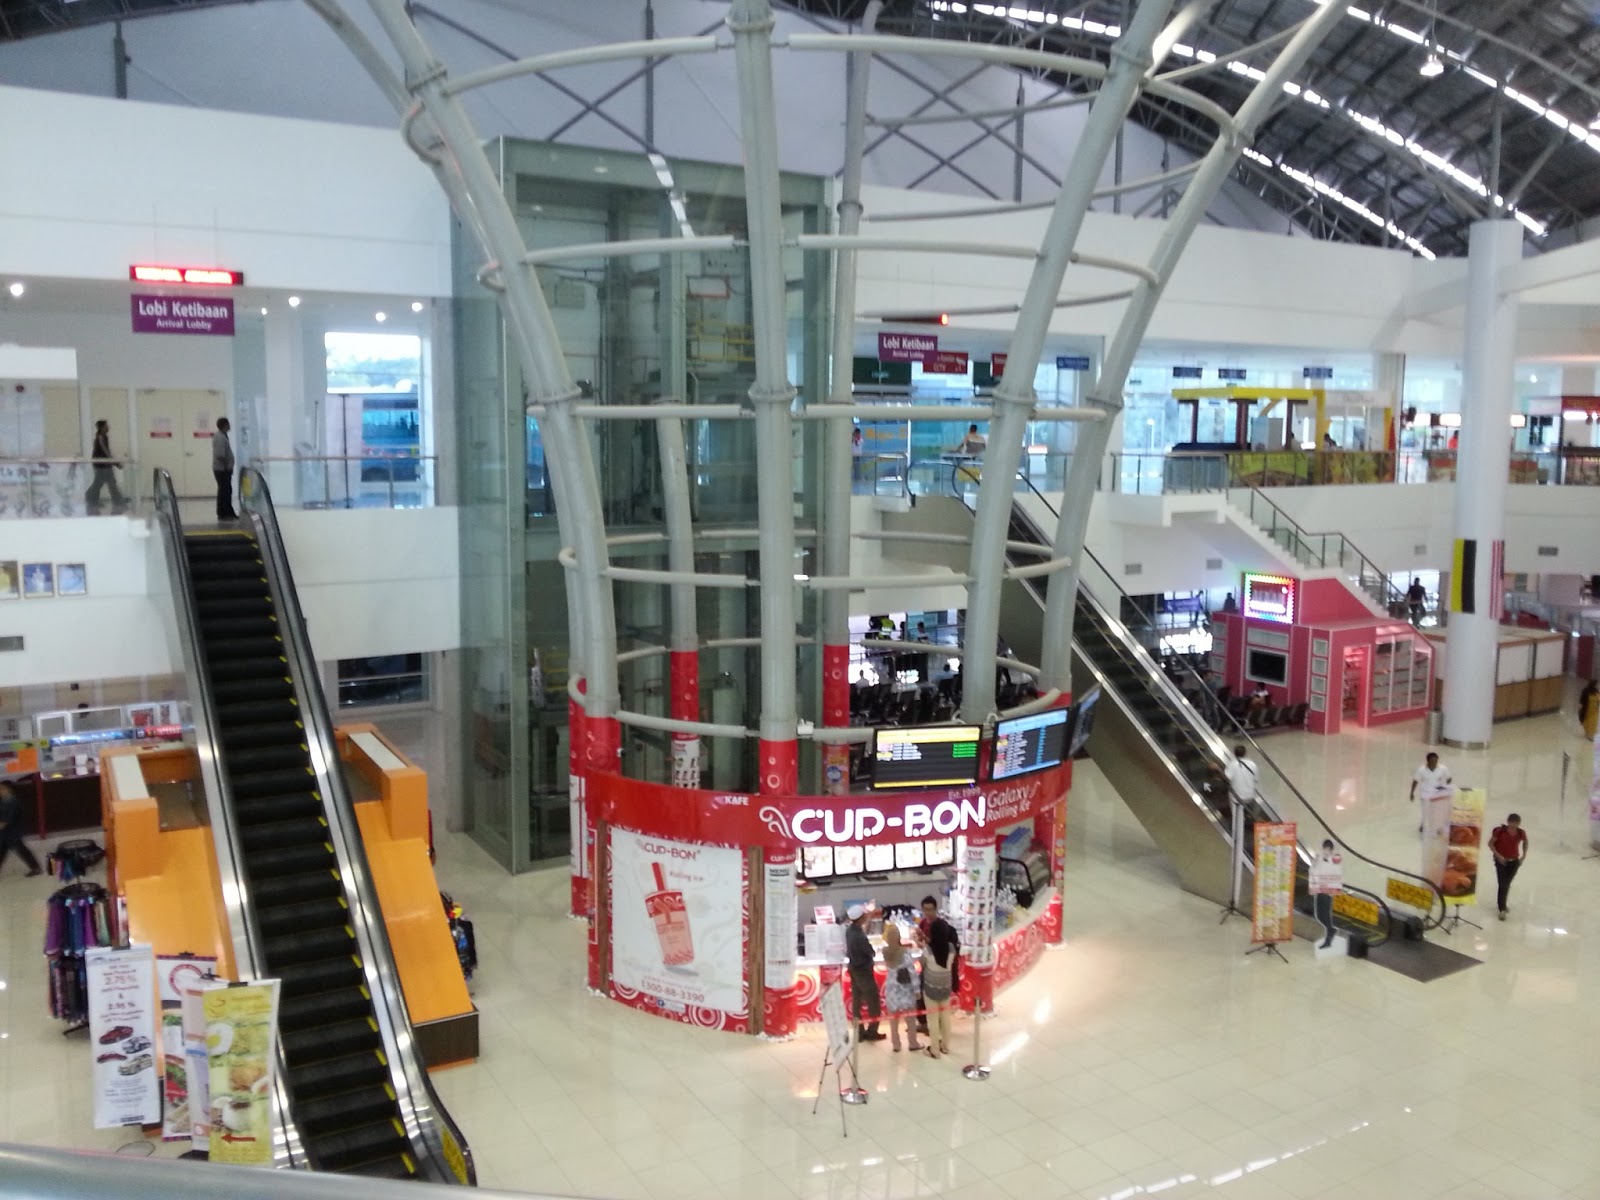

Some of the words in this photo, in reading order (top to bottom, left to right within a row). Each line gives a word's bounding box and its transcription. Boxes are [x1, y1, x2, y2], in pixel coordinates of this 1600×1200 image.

[138, 300, 167, 316] Lobi
[171, 301, 228, 318] Ketibaan
[156, 318, 183, 328] Arrival
[186, 320, 211, 331] Lobby
[883, 336, 900, 350] Lobi
[902, 338, 935, 351] Ketibaan
[724, 796, 750, 806] KAFE
